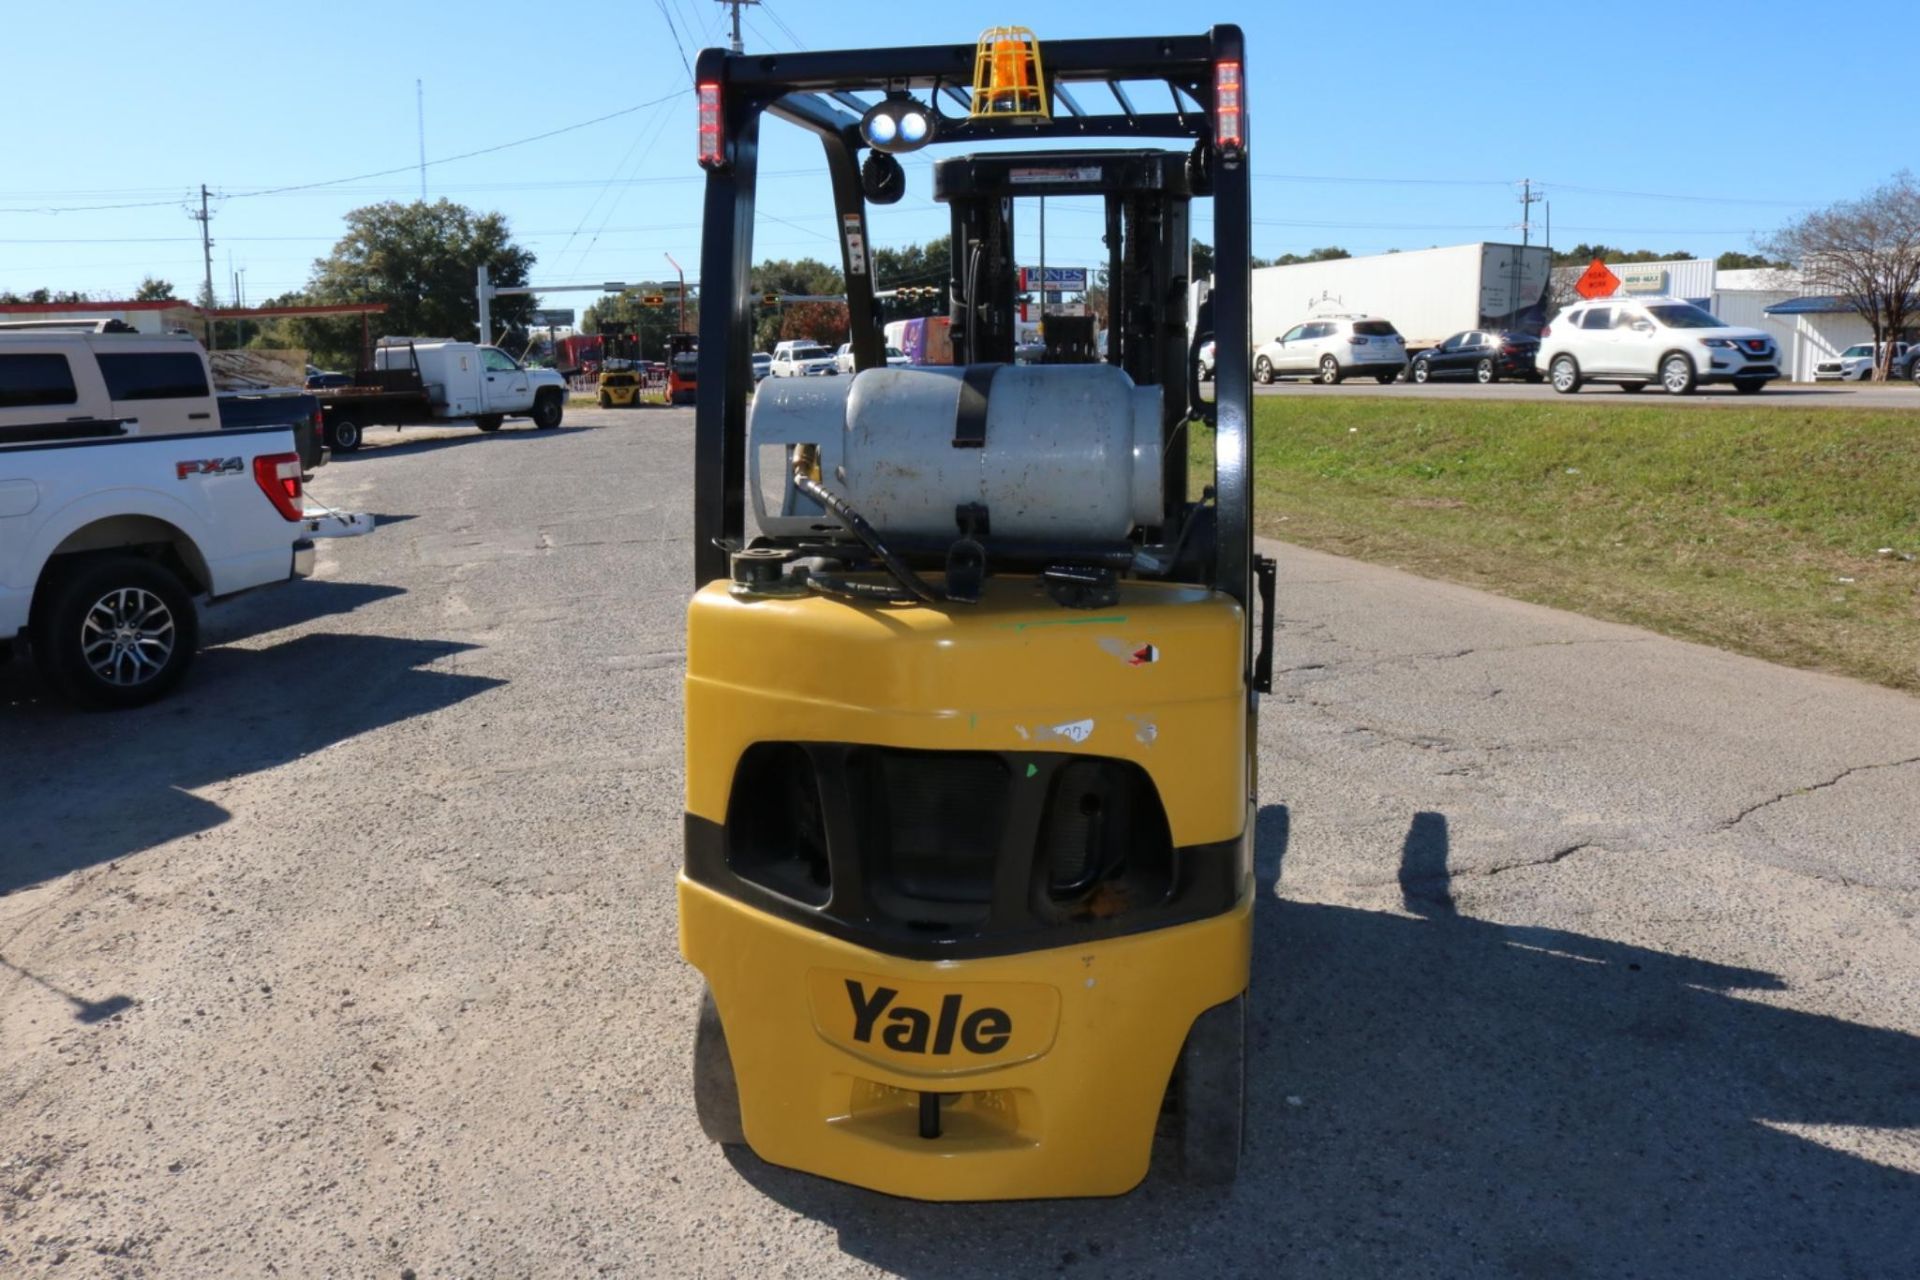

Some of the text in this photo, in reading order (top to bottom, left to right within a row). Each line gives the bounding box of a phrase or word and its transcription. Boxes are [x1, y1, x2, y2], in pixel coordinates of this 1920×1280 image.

[1029, 269, 1084, 281] JONES
[176, 456, 244, 480] FX4
[844, 978, 1013, 1056] Yale
